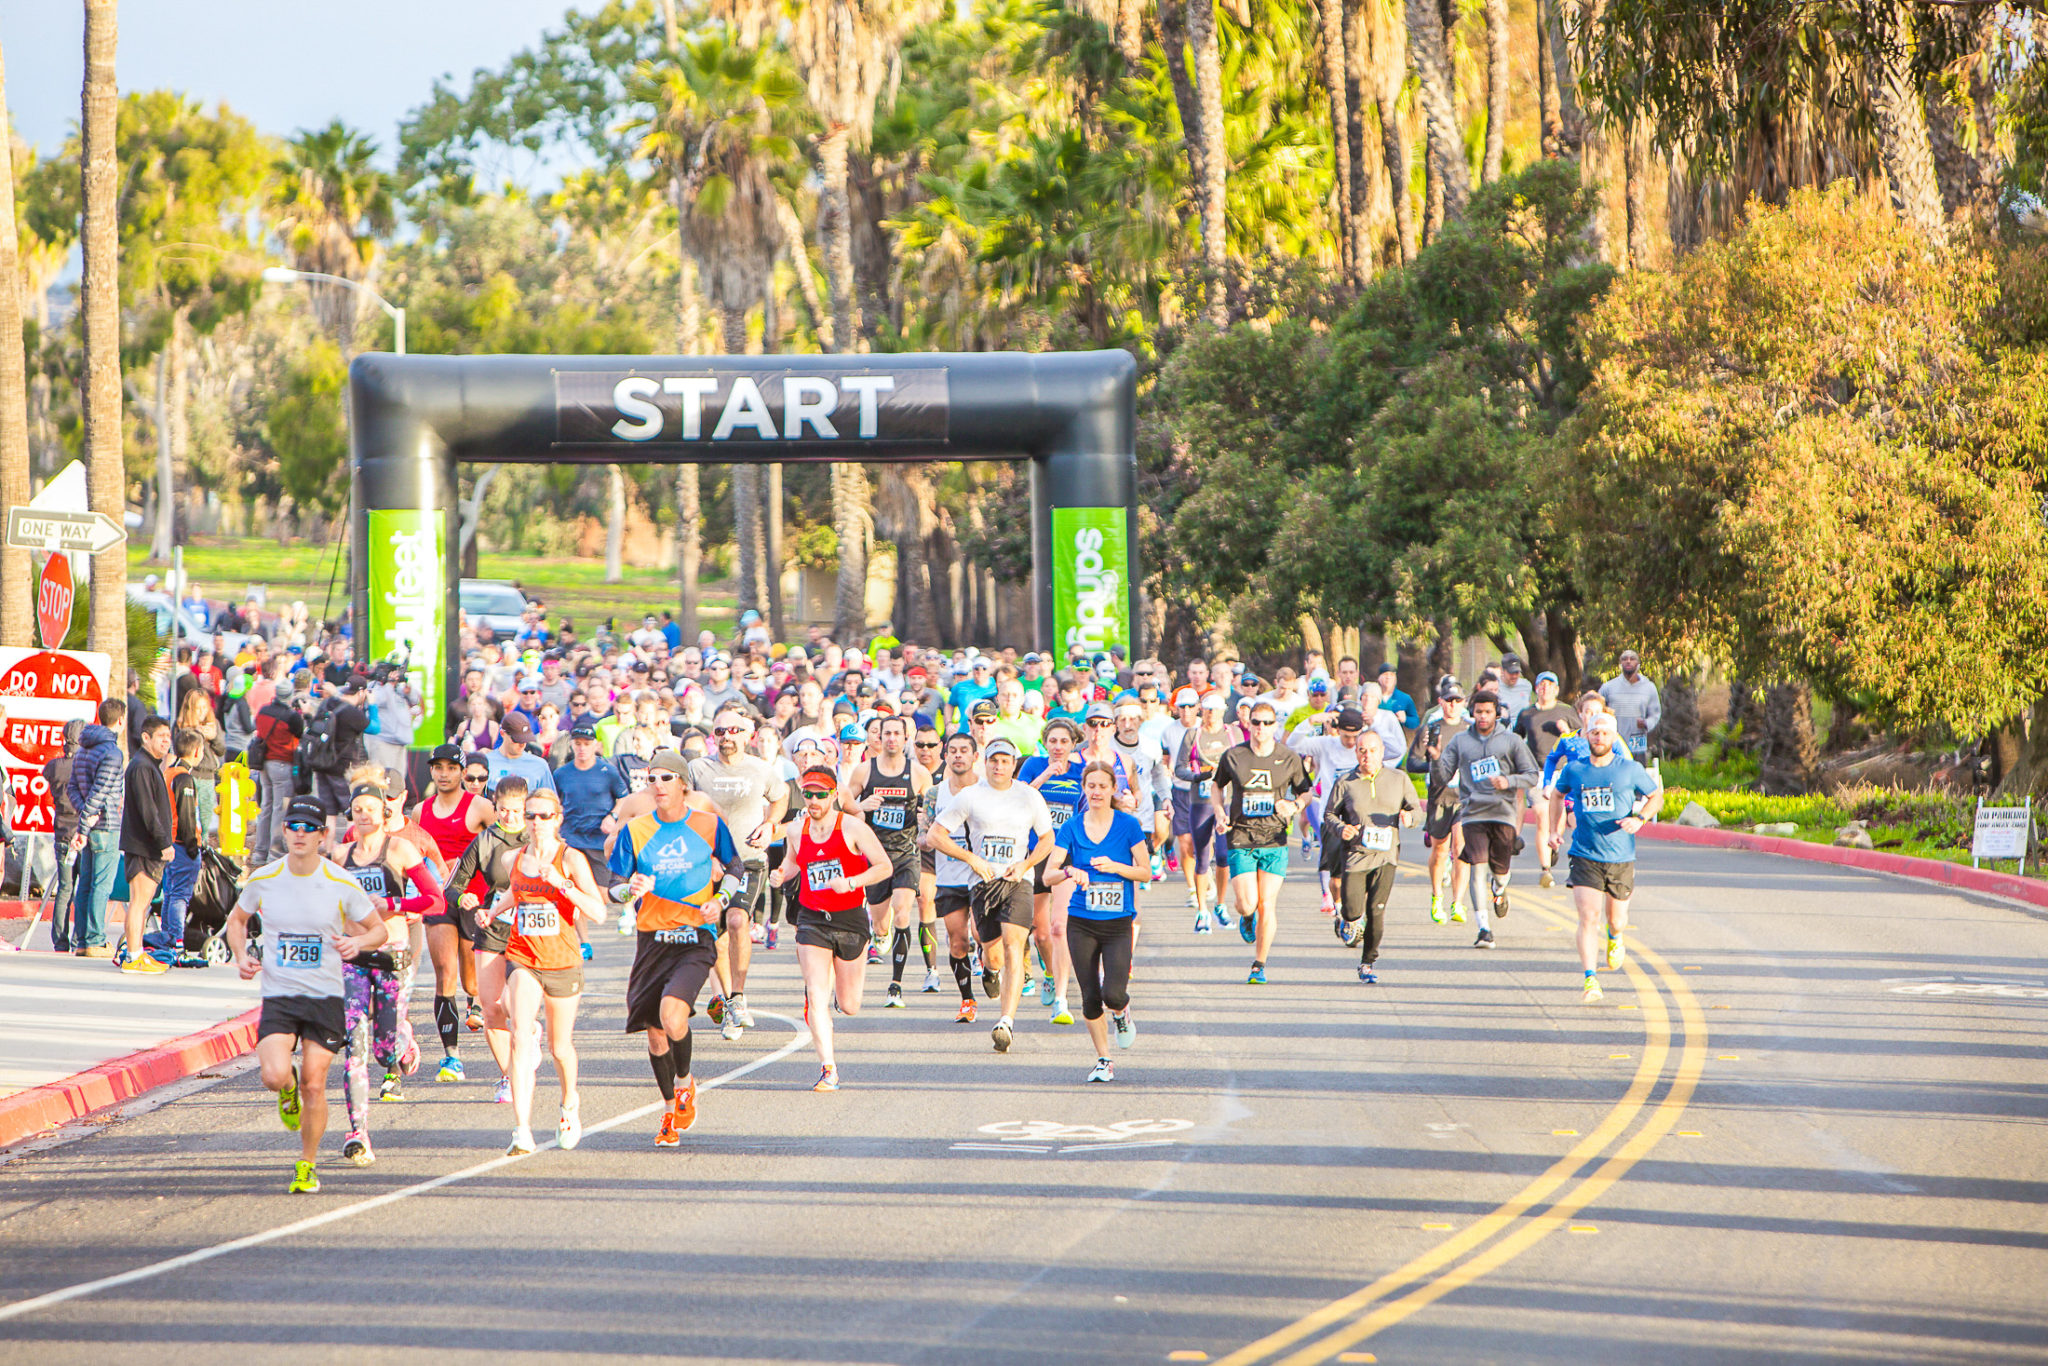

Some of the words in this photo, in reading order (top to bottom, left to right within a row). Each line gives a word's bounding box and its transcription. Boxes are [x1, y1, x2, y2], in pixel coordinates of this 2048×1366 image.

[611, 375, 895, 441] START
[22, 520, 54, 537] ONE
[60, 523, 92, 539] WAY
[40, 577, 71, 622] STOP
[10, 670, 38, 692] DO
[52, 673, 92, 695] NOT
[11, 723, 64, 746] ENTE
[1584, 794, 1611, 807] 1312
[876, 810, 903, 824] 1318
[1977, 811, 1990, 820] NO
[1992, 810, 2028, 820] PARKING
[983, 843, 1013, 858] 1140
[810, 867, 842, 884] 1473
[1090, 891, 1121, 906] 1132
[521, 912, 556, 928] 1356
[280, 943, 320, 962] 1259
